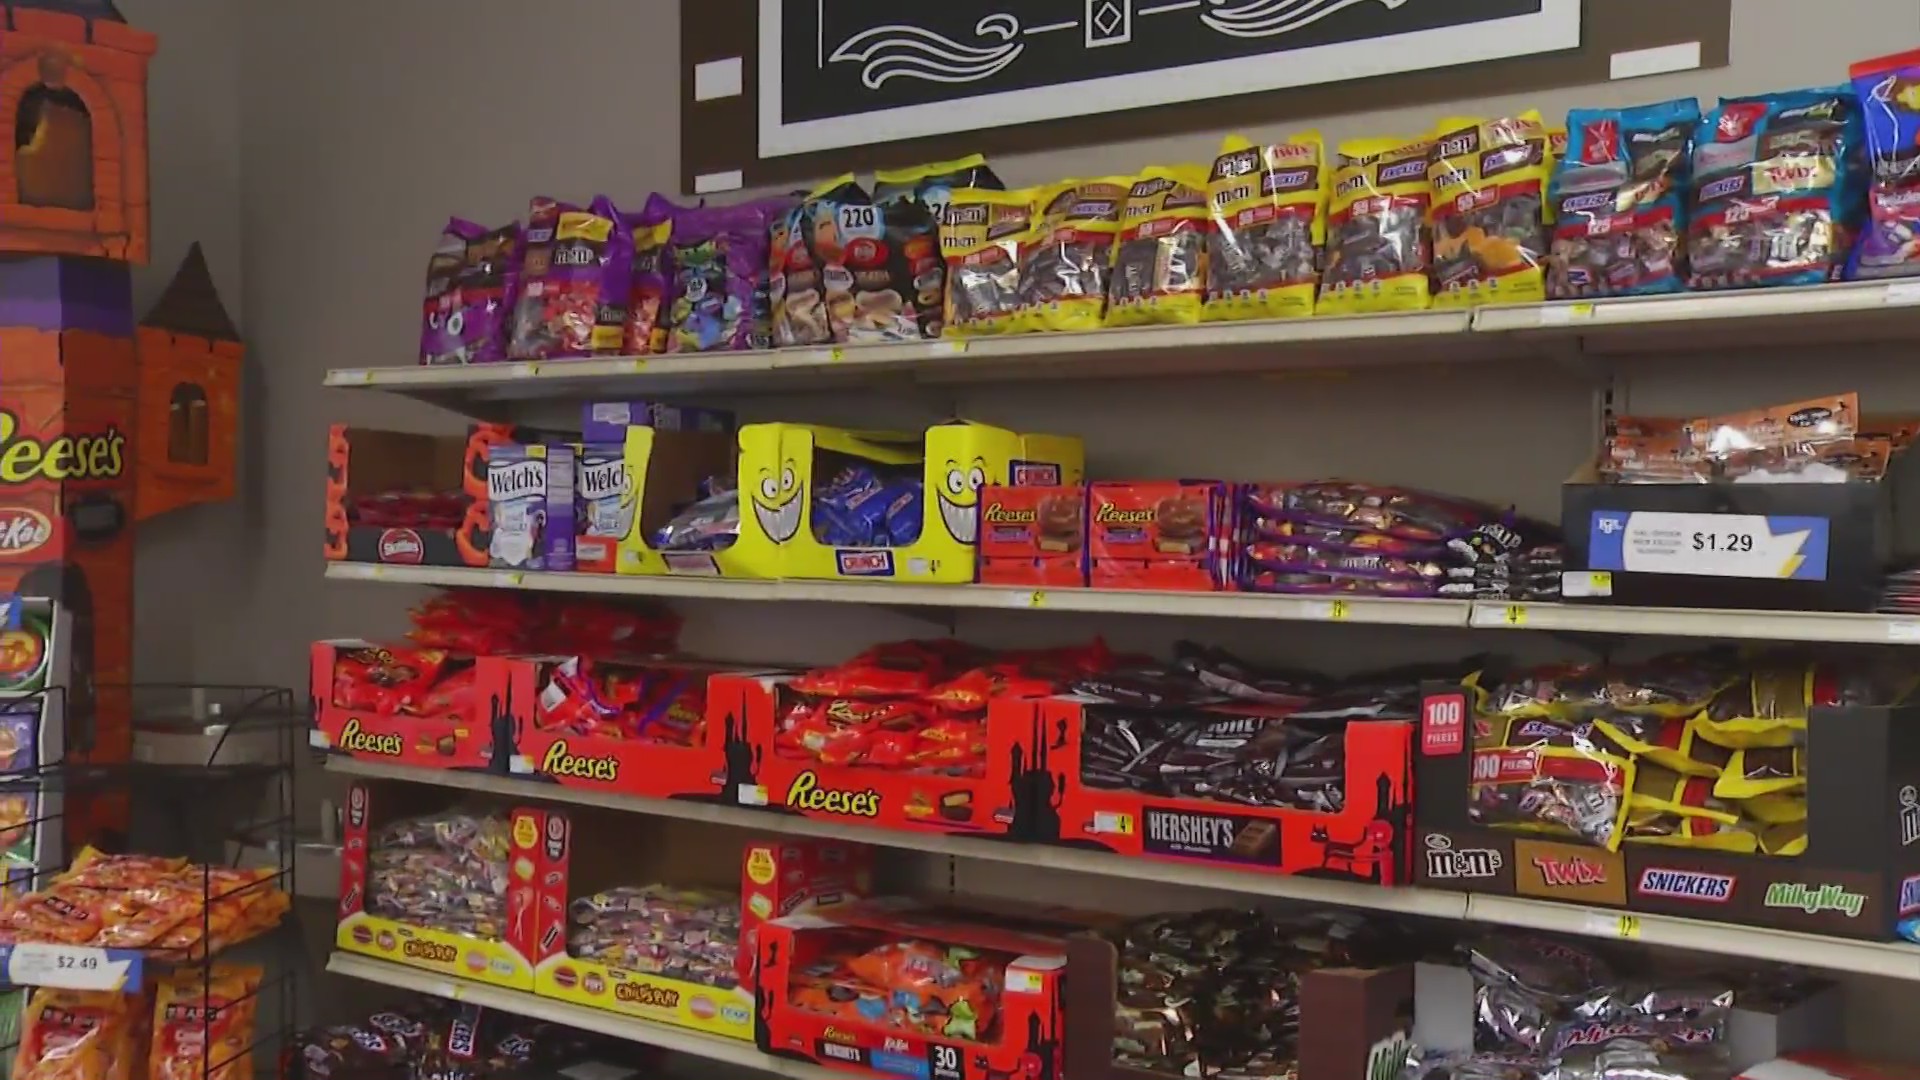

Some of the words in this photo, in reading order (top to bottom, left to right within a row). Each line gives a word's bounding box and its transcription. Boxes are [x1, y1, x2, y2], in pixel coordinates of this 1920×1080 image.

[843, 207, 875, 228] 220
[491, 464, 543, 493] Welch's
[1692, 531, 1753, 552] $1.29
[1427, 701, 1460, 726] 100
[341, 718, 403, 756] Reese's
[543, 739, 619, 781] Reese's
[787, 769, 880, 817] Reese's
[1149, 811, 1235, 848] HERSHEY'S
[1643, 871, 1730, 898] SNICKERS
[934, 1045, 957, 1069] 30
